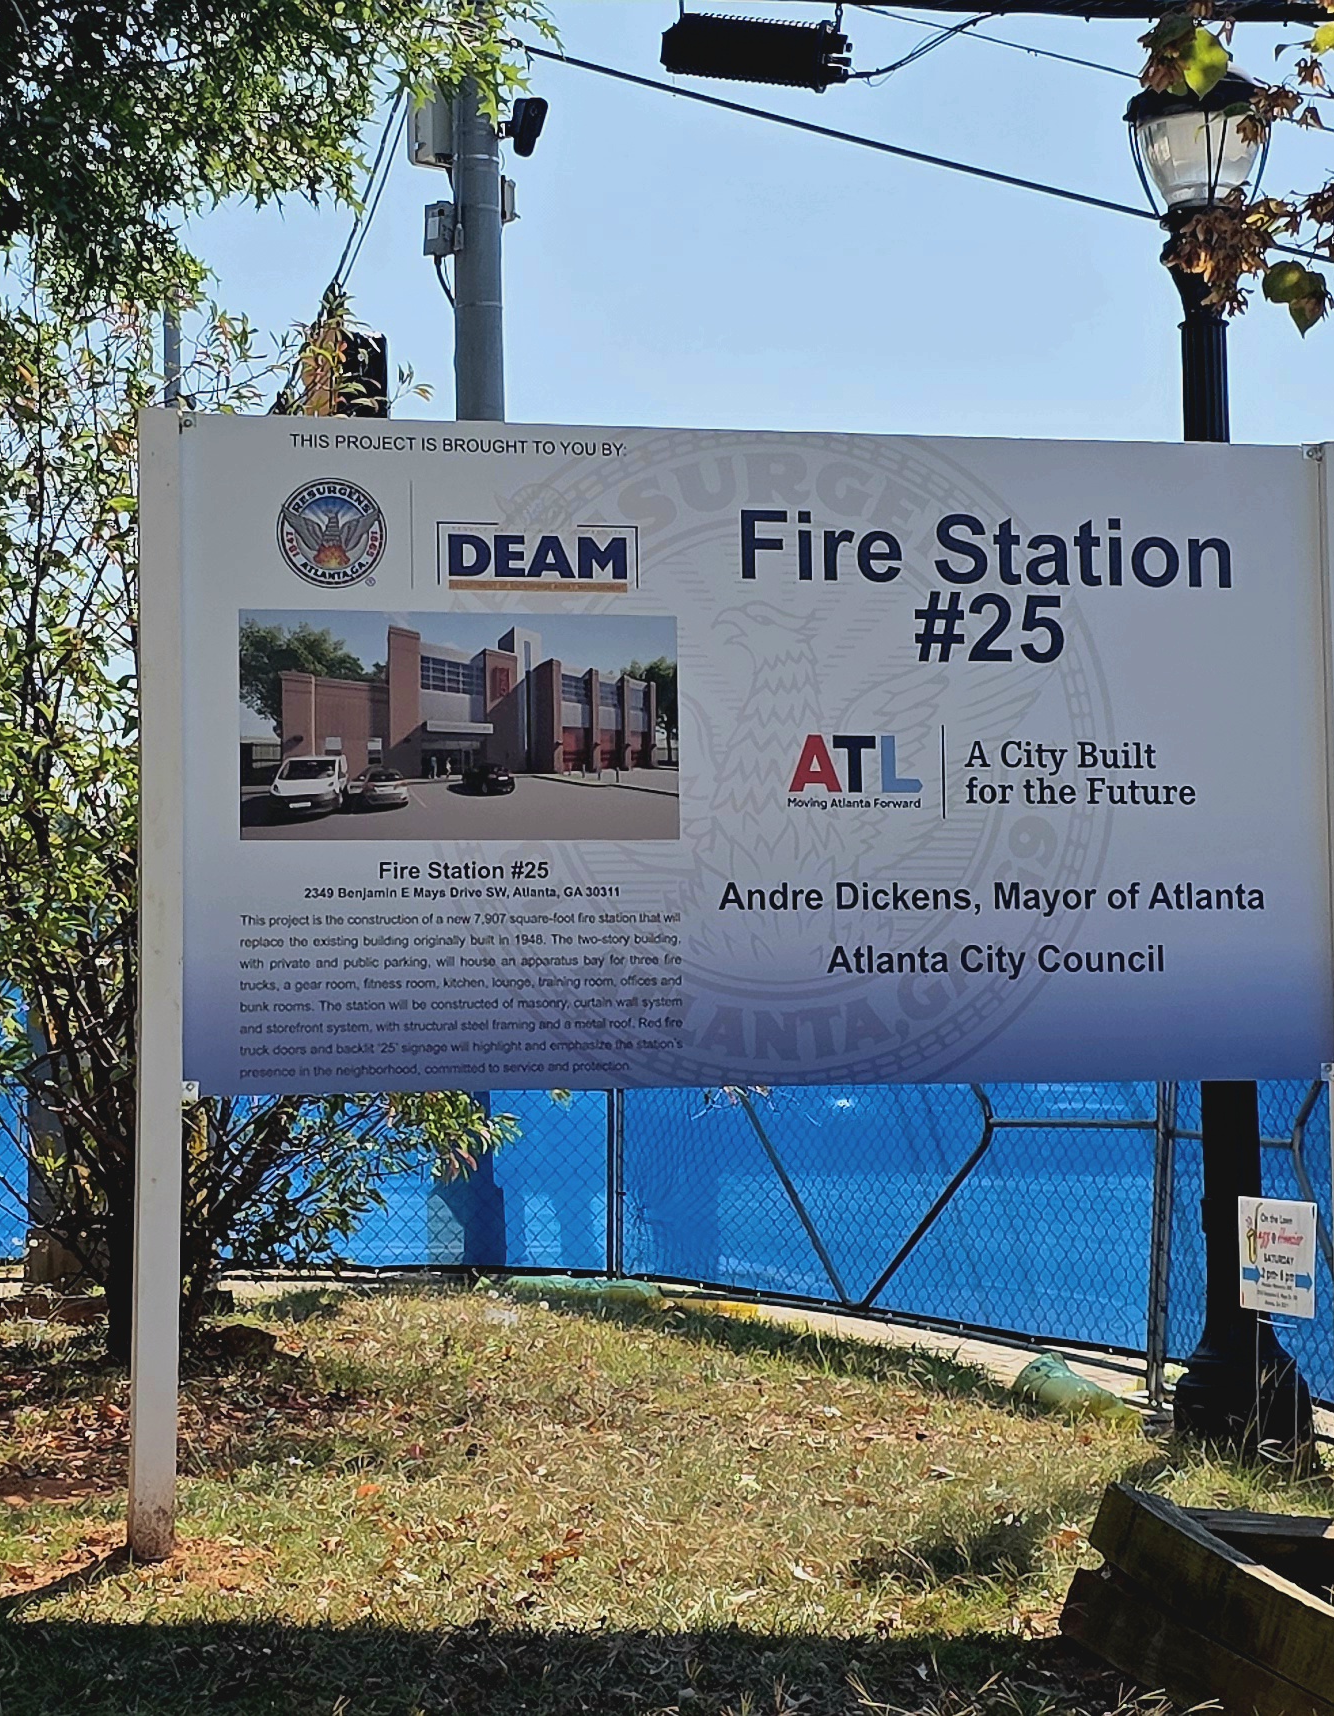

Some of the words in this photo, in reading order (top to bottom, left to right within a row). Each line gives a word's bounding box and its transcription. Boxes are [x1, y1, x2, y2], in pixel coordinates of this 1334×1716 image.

[289, 433, 330, 449] THIS
[335, 435, 416, 451] PROJECT
[421, 437, 437, 452] IS
[442, 438, 528, 455] BROUGHT
[532, 441, 555, 455] TO
[559, 442, 597, 457] YOU
[602, 443, 627, 457] BY:
[292, 485, 372, 514] RESURGENS
[448, 534, 627, 579] DEAM
[738, 509, 903, 583] Fire
[934, 514, 1234, 589] Station
[914, 591, 1066, 663] #25
[788, 734, 924, 793] ATL
[965, 741, 990, 768] A
[1000, 741, 1068, 776] City
[1077, 742, 1157, 769] Built
[965, 777, 1013, 804] for
[1024, 778, 1077, 805] the
[1086, 778, 1197, 806] Future
[788, 797, 828, 810] Moving
[830, 797, 871, 809] Atlanta
[873, 798, 922, 809] Forward
[379, 861, 421, 880] Fire
[427, 861, 504, 880] Station
[510, 860, 549, 879] #25
[304, 887, 334, 898] 2349
[338, 887, 397, 900] Benjamin
[401, 887, 409, 898] E
[414, 887, 446, 900] Mays
[450, 886, 482, 897] Drive
[486, 886, 510, 899] SW,
[513, 886, 560, 898] Atlanta,
[563, 886, 583, 897] GA
[585, 886, 620, 897] 30311
[718, 882, 824, 911] Andre
[835, 882, 982, 916] Dickens,
[993, 882, 1097, 918] Mayor
[1107, 882, 1141, 910] of
[1148, 882, 1265, 910] Atlanta
[240, 914, 265, 926] This
[269, 914, 310, 929] project
[312, 914, 323, 926] is
[325, 914, 345, 925] the
[347, 914, 419, 925] construction
[421, 914, 434, 925] of
[435, 916, 444, 925] a
[447, 916, 471, 925] new
[473, 913, 507, 926] 7,907
[509, 913, 575, 927] square-foot
[577, 913, 595, 924] fire
[598, 913, 636, 924] station
[639, 913, 661, 923] that
[663, 913, 681, 923] will
[239, 936, 285, 950] replace
[289, 936, 309, 947] the
[313, 936, 359, 950] existing
[363, 935, 409, 949] building
[413, 935, 466, 949] originally
[470, 935, 495, 946] built
[499, 935, 509, 946] in
[515, 934, 546, 945] 1948.
[551, 934, 573, 945] The
[577, 934, 631, 948] two-story
[633, 934, 681, 947] building,
[239, 958, 264, 969] with
[269, 958, 311, 971] private
[315, 957, 339, 968] and
[343, 957, 379, 971] public
[383, 956, 431, 970] parking,
[436, 956, 455, 967] will
[460, 956, 497, 967] house
[501, 958, 516, 966] an
[520, 955, 579, 969] apparatus
[583, 954, 605, 968] bay
[609, 954, 625, 965] for
[629, 954, 659, 965] three
[664, 954, 683, 965] fire
[827, 945, 949, 974] Atlanta
[960, 944, 1026, 980] City
[1037, 944, 1165, 973] Council
[239, 980, 279, 992] trucks,
[283, 982, 291, 990] a
[295, 981, 322, 993] gear
[325, 981, 360, 991] room,
[363, 978, 403, 989] fitness
[405, 980, 439, 990] room,
[443, 978, 489, 990] kitchen,
[491, 977, 535, 991] lounge,
[538, 977, 581, 990] training
[584, 979, 617, 989] room,
[619, 976, 658, 987] offices
[661, 976, 683, 986] and
[239, 1001, 269, 1012] bunk
[273, 1003, 315, 1012] rooms.
[320, 1000, 343, 1011] The
[345, 1000, 386, 1011] station
[389, 1000, 408, 1011] will
[411, 1000, 427, 1010] be
[431, 999, 499, 1010] constructed
[501, 999, 514, 1009] of
[517, 1000, 569, 1012] masonry,
[573, 998, 613, 1008] curtain
[615, 997, 639, 1008] wall
[641, 997, 683, 1010] system
[239, 1022, 263, 1033] and
[266, 1021, 324, 1033] storefront
[326, 1021, 373, 1035] system,
[375, 1020, 400, 1032] with
[403, 1020, 458, 1031] structural
[460, 1019, 489, 1031] steel
[491, 1019, 536, 1033] framing
[539, 1018, 561, 1030] and
[564, 1020, 571, 1029] a
[575, 1018, 606, 1029] metal
[609, 1017, 635, 1029] roof.
[638, 1017, 662, 1028] Red
[665, 1017, 683, 1028] fire
[239, 1044, 268, 1055] truck
[272, 1044, 307, 1055] doors
[310, 1043, 333, 1054] and
[401, 1041, 448, 1056] signage
[451, 1041, 469, 1052] will
[473, 1040, 522, 1055] highlight
[524, 1040, 547, 1051] and
[549, 1039, 613, 1053] emphasize
[615, 1039, 634, 1050] the
[635, 1038, 683, 1050] station's
[239, 1068, 296, 1080] presence
[299, 1065, 310, 1076] in
[313, 1065, 333, 1076] the
[335, 1064, 421, 1078] neighborhood,
[424, 1063, 486, 1074] committed
[488, 1062, 500, 1073] to
[503, 1062, 545, 1073] service
[547, 1061, 569, 1073] and
[572, 1061, 633, 1075] protection.
[1263, 1253, 1295, 1265] SATURDAY
